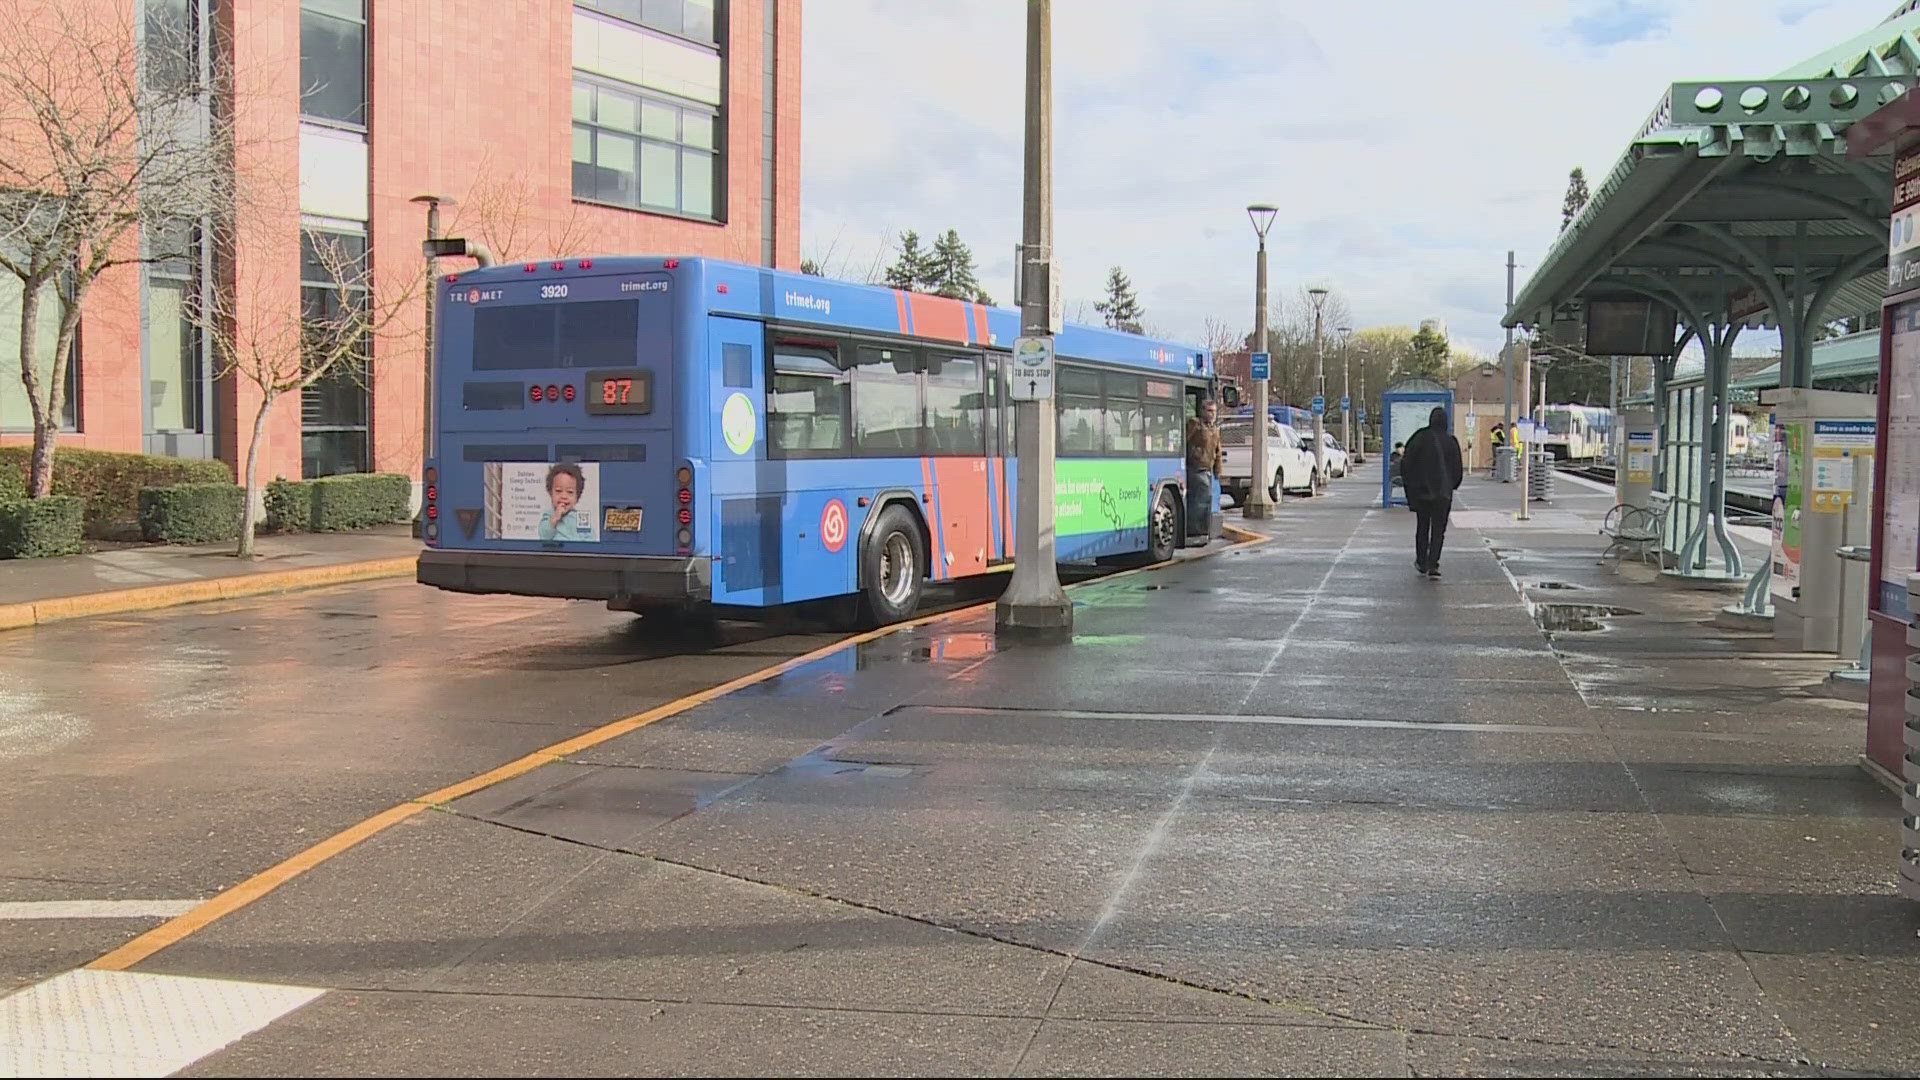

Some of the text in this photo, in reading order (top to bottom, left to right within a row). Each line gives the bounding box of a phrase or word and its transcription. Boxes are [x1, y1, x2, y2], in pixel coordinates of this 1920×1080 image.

[1893, 183, 1905, 206] NE
[621, 281, 668, 293] trimet.org
[1890, 264, 1904, 287] City
[541, 284, 568, 298] 3920
[785, 290, 831, 315] trimet.org
[1015, 368, 1051, 377] TO BUS STOP
[604, 380, 632, 404] 87
